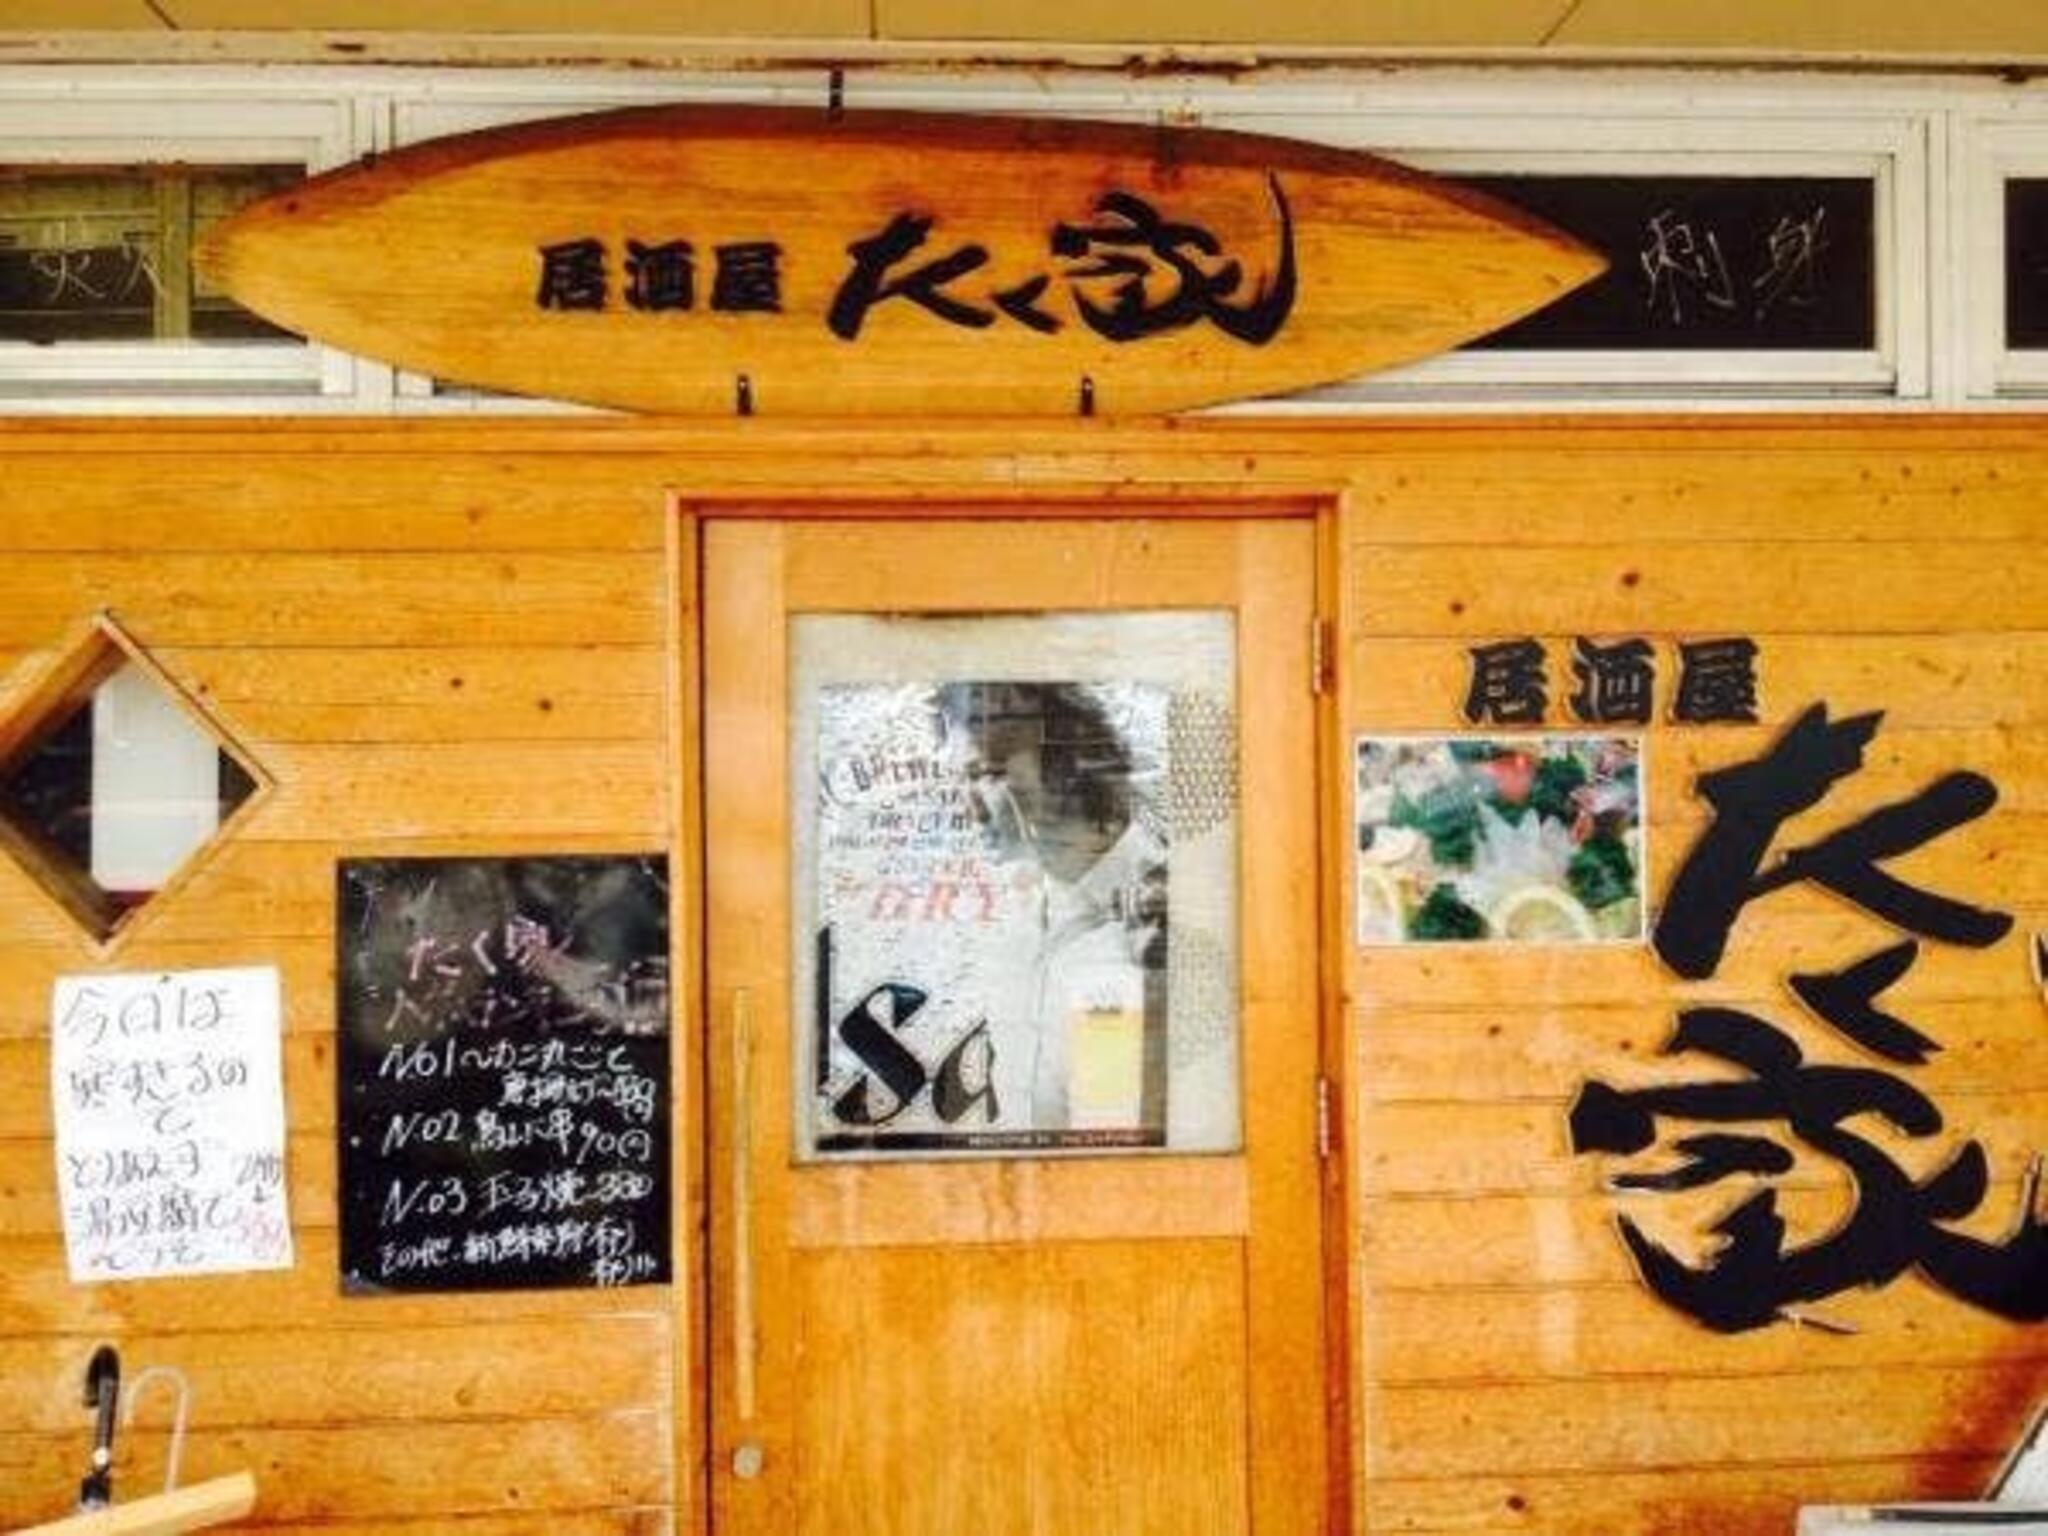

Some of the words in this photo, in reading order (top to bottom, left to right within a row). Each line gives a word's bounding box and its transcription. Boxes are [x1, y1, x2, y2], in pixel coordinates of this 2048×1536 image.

[536, 239, 783, 313] 居酒屋
[827, 170, 1298, 346] たく家
[1463, 636, 1760, 726] 居酒屋
